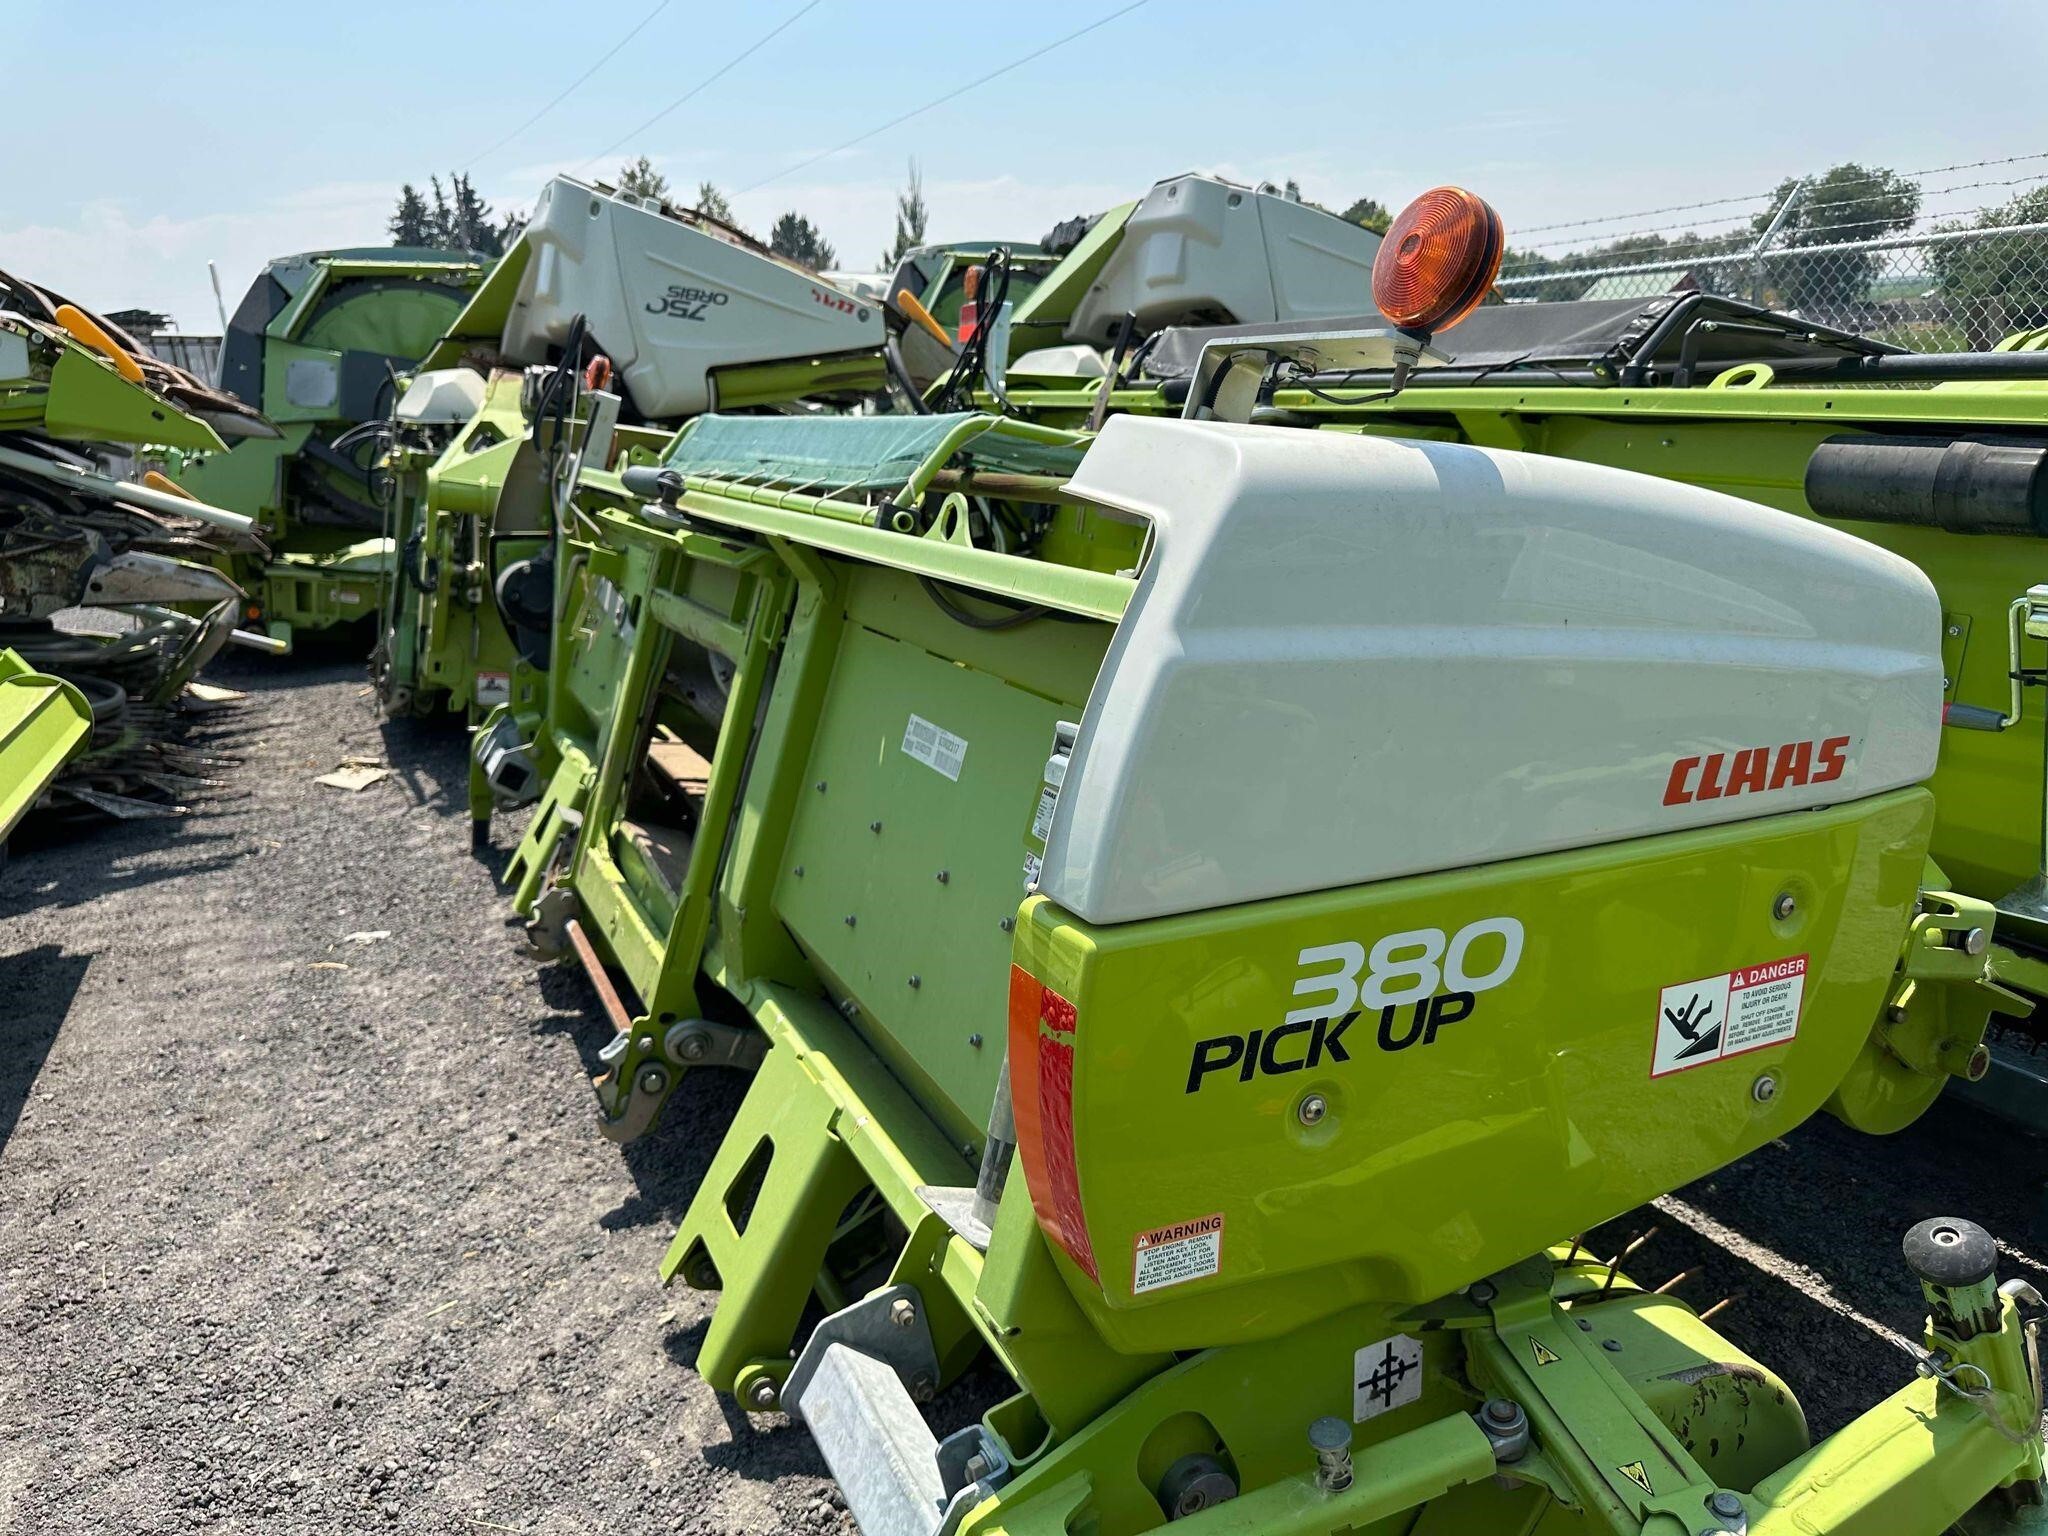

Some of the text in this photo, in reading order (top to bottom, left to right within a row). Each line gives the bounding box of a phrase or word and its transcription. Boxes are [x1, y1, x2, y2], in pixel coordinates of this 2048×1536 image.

[666, 285, 729, 306] ORBIS
[1663, 735, 1850, 806] CLAAS
[1285, 917, 1524, 1024] 380
[1749, 958, 1805, 983] DANGER
[1742, 993, 1788, 1009] INJURY OR DEATH
[1743, 982, 1792, 1000] TO AVOID SERIOUS
[1741, 1012, 1755, 1021] SHUT
[1766, 1005, 1785, 1014] ENGINE
[1742, 1019, 1760, 1028] REMOVE
[1764, 1013, 1783, 1022] STARTER
[1728, 1030, 1745, 1039] BEFORE
[1777, 1018, 1793, 1026] HEADER
[1734, 1035, 1751, 1044] MAKING
[1762, 1025, 1791, 1037] ADJUSTMENTS
[1185, 991, 1475, 1094] PICK UP
[1149, 1217, 1221, 1244] WARNING
[1144, 1247, 1160, 1256] STOP
[1188, 1234, 1213, 1244] REMOVE
[1147, 1250, 1174, 1261] STARTER
[1138, 1272, 1162, 1282] BEFORE
[1165, 1264, 1192, 1275] OPENING
[1193, 1258, 1215, 1267] DOORS
[1144, 1259, 1165, 1268] LISTEN
[1167, 1255, 1180, 1263] AND
[1153, 1260, 1186, 1272] MOVEMENT
[1198, 1252, 1215, 1260] STOP
[1148, 1275, 1172, 1285] MAKING
[1173, 1264, 1216, 1279] ADJUSTMENTS
